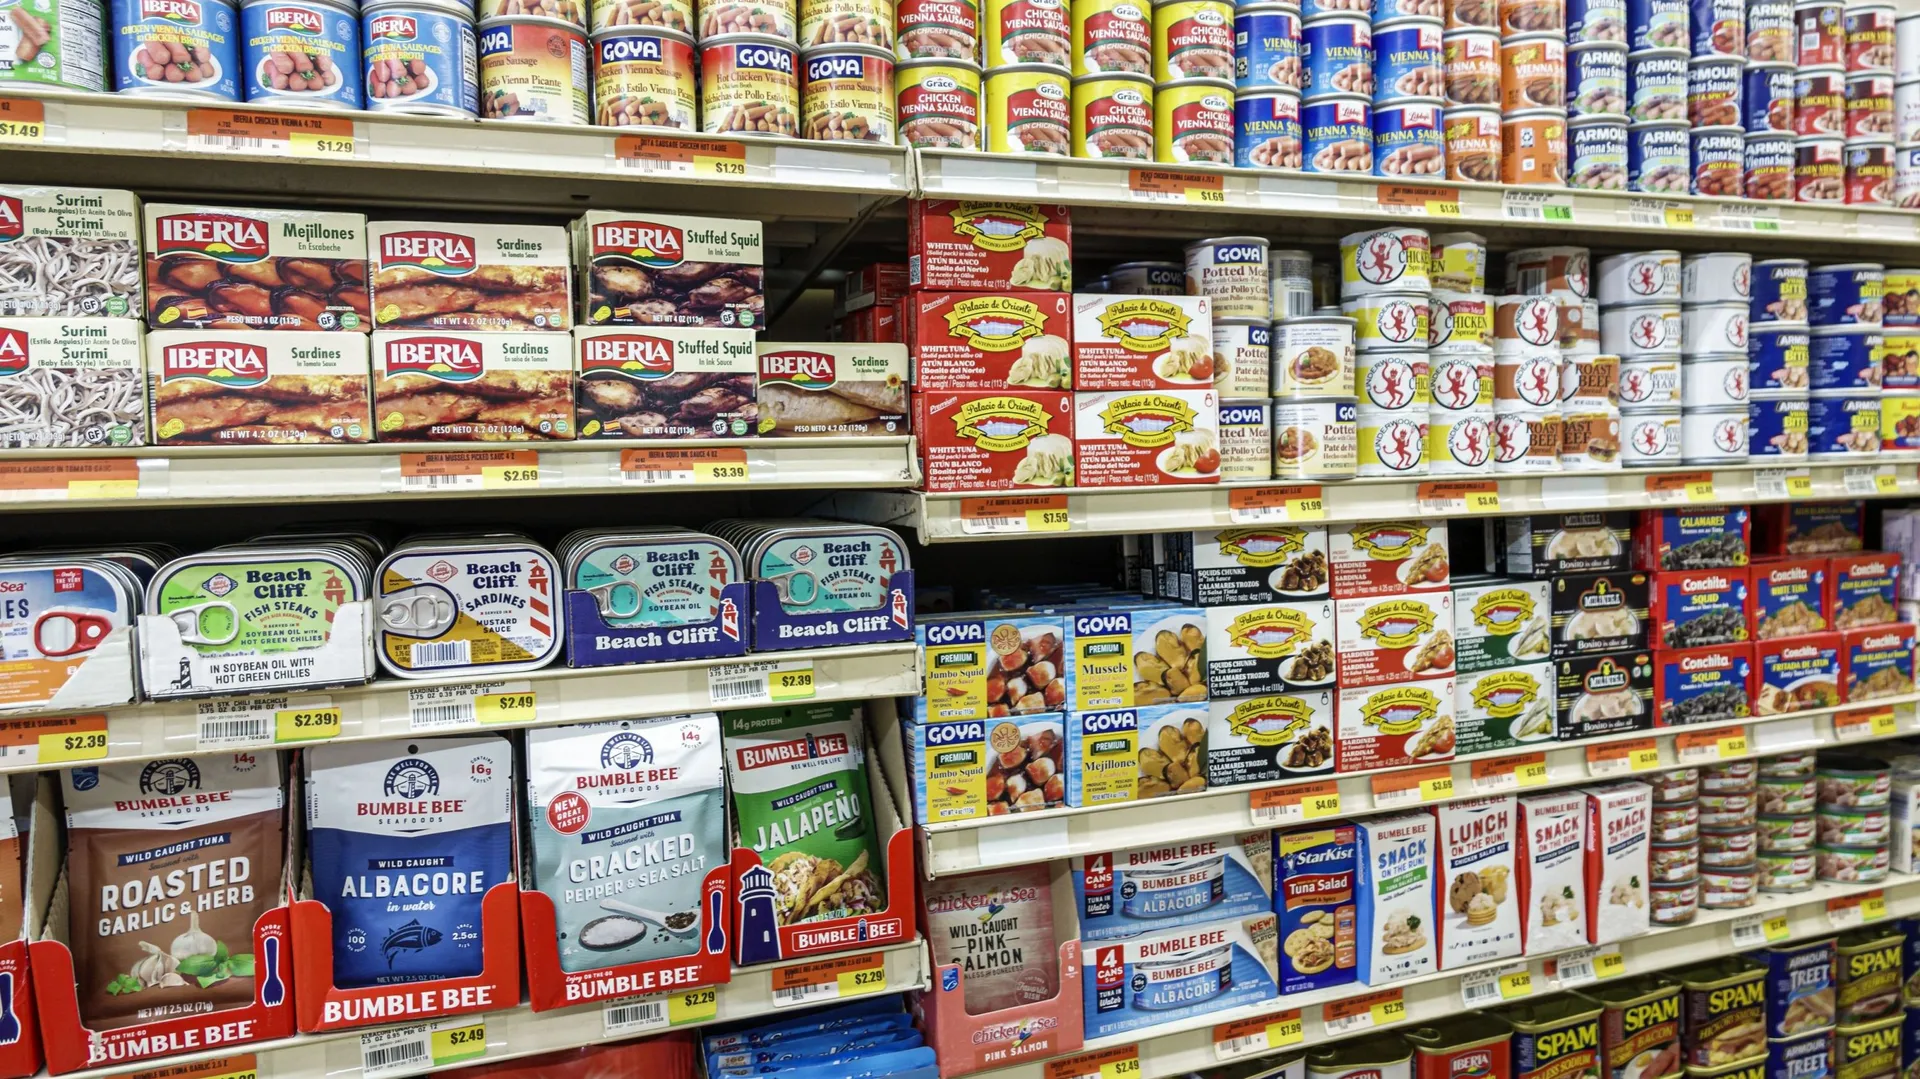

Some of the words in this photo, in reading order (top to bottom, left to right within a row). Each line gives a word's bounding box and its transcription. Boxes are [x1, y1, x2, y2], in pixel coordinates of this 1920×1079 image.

[143, 0, 198, 17] IBERIA
[269, 12, 321, 32] IBERIA
[603, 41, 659, 62] GOYA
[506, 58, 538, 67] Sausage
[740, 48, 792, 73] GOYA
[809, 59, 861, 79] GOYA
[502, 75, 530, 86] Vienna
[531, 75, 562, 88] Picante
[731, 73, 763, 82] Chicken
[918, 93, 961, 105] CHICKEN
[901, 103, 936, 114] VIENNA
[937, 104, 976, 117] SAUSAGES
[233, 115, 254, 124] IBERIA
[254, 116, 280, 125] CHICKEN
[281, 117, 303, 128] VIENNA
[0, 123, 39, 139] $1.49
[1307, 128, 1348, 140] VIENNA
[317, 140, 353, 153] $1.29
[715, 161, 745, 175] $1.29
[56, 193, 103, 208] Surimi
[1201, 190, 1224, 202] $1.69
[24, 205, 47, 215] (Estilo
[48, 206, 79, 216] Angulas)
[79, 207, 87, 215] En
[88, 208, 106, 216] Aceite
[107, 208, 117, 216] De
[117, 209, 133, 217] Oliva
[56, 216, 104, 230] Surimi
[32, 227, 53, 237] (Baby
[53, 228, 68, 236] Eels
[69, 228, 92, 238] Style)
[102, 229, 118, 238] Olive
[119, 229, 128, 238] Oil
[162, 219, 265, 245] IBERIA
[282, 222, 355, 243] Mejillones
[596, 225, 682, 254] IBERIA
[686, 230, 728, 246] Stuffed
[730, 233, 760, 249] Squid
[298, 242, 308, 251] En
[309, 243, 341, 252] Escobeche
[384, 237, 473, 259] IBERIA
[496, 238, 543, 252] Sardines
[1356, 231, 1396, 269] UNDERWOOD
[507, 251, 523, 259] Tomato
[523, 252, 539, 260] Sauce
[707, 248, 713, 257] In
[714, 248, 722, 257] Ink
[723, 249, 741, 258] Sauce
[1217, 247, 1262, 262] GOYA
[1202, 266, 1244, 279] Potted
[226, 315, 245, 325] PESO
[245, 315, 263, 325] NETO
[263, 316, 269, 325] 4
[269, 316, 279, 326] OZ
[280, 316, 301, 327] (113g)
[1444, 316, 1488, 329] CHICKEN
[851, 356, 889, 367] Sardinas
[1651, 379, 1676, 390] HAM
[966, 401, 996, 414] Palacio
[998, 401, 1006, 409] de
[1007, 399, 1038, 414] Oriente
[431, 425, 451, 435] PESO
[451, 425, 472, 434] NETO
[473, 425, 487, 434] 4.2
[487, 424, 499, 434] OZ
[500, 424, 525, 435] (120g)
[425, 453, 444, 463] IBERIA
[444, 453, 470, 462] MUSSELS
[471, 452, 490, 461] PICKED
[648, 450, 665, 459] IBERIA
[665, 450, 680, 459] SQUID
[689, 449, 706, 458] SAUCE
[1100, 455, 1130, 463] BLANCO
[503, 470, 539, 482] $2.69
[712, 466, 745, 478] $3.39
[1300, 500, 1322, 512] $1.99
[1043, 512, 1068, 524] $7.59
[1680, 515, 1726, 528] CALAMARES
[646, 549, 700, 563] Beach
[246, 568, 312, 583] Beach
[651, 562, 695, 577] Cliff
[253, 582, 305, 599] Cliff
[1683, 577, 1728, 592] Conchita
[465, 592, 526, 612] SARDINES
[1691, 593, 1719, 605] SQUID
[244, 605, 272, 623] FISH
[274, 601, 319, 620] STEAKS
[1077, 609, 1129, 629] GOYA
[475, 617, 518, 627] MUSTARD
[482, 625, 512, 634] SAUCE
[245, 630, 286, 638] SOYBEAN
[287, 629, 301, 637] OIL
[1088, 642, 1120, 655] PREMIUM
[209, 664, 221, 674] IN
[223, 660, 270, 673] SOYBEAN
[271, 659, 288, 670] OIL
[289, 657, 315, 668] WITH
[1081, 663, 1128, 675] Mussels
[215, 674, 232, 684] HOT
[232, 671, 272, 683] GREEN
[273, 668, 311, 680] CHILIES
[781, 675, 812, 687] $2.39
[409, 686, 440, 695] SARDINES
[442, 684, 472, 693] MUSTARD
[499, 696, 533, 710] $2.49
[294, 712, 333, 728] $2.39
[64, 734, 107, 751] $2.39
[742, 742, 806, 768] BUMBLE
[818, 735, 846, 753] BEE
[1432, 779, 1453, 792] $3.69
[115, 795, 197, 813] BUMBLE
[199, 790, 232, 804] BEE
[357, 801, 428, 817] BUMBLE
[431, 800, 464, 814] BEE
[554, 796, 581, 812] NEW
[1315, 798, 1338, 810] $4.09
[378, 816, 444, 825] SEAFOODS
[557, 807, 582, 820] GREAT
[753, 788, 862, 853] JALAPEÑO
[557, 816, 585, 829] TASTE!
[1449, 810, 1508, 847] LUNCH
[569, 833, 695, 884] CRACKED
[1378, 839, 1427, 870] SNACK
[101, 856, 251, 910] ROASTED
[341, 870, 485, 899] ALBACORE
[1289, 880, 1314, 893] Tuna
[1317, 876, 1348, 892] Salad
[99, 909, 176, 937] GARLIC
[180, 902, 193, 915] &
[198, 885, 256, 912] HERB
[387, 901, 402, 913] in
[403, 900, 436, 913] water
[949, 917, 1019, 939] WILD-CAUGHT
[1140, 937, 1198, 958] BUMBLE
[1200, 930, 1226, 947] BEE
[1789, 949, 1828, 970] ARMOUR
[854, 968, 883, 985] $2.29
[1790, 964, 1829, 990] TREET
[684, 991, 716, 1007] $2.29
[1153, 979, 1217, 1005] ALBACORE
[1709, 980, 1766, 1014] SPAM
[324, 990, 438, 1024] BUMBLE
[441, 985, 493, 1009] BEE
[1384, 1000, 1405, 1015] $2.29
[450, 1028, 485, 1046] $2.49
[1280, 1022, 1302, 1037] $7.99
[1536, 1022, 1598, 1060] SPAM
[984, 1047, 1007, 1062] PINK
[1010, 1039, 1049, 1057] SALMON
[1115, 1060, 1140, 1073] $2.49
[1452, 1053, 1489, 1072] IBERIA
